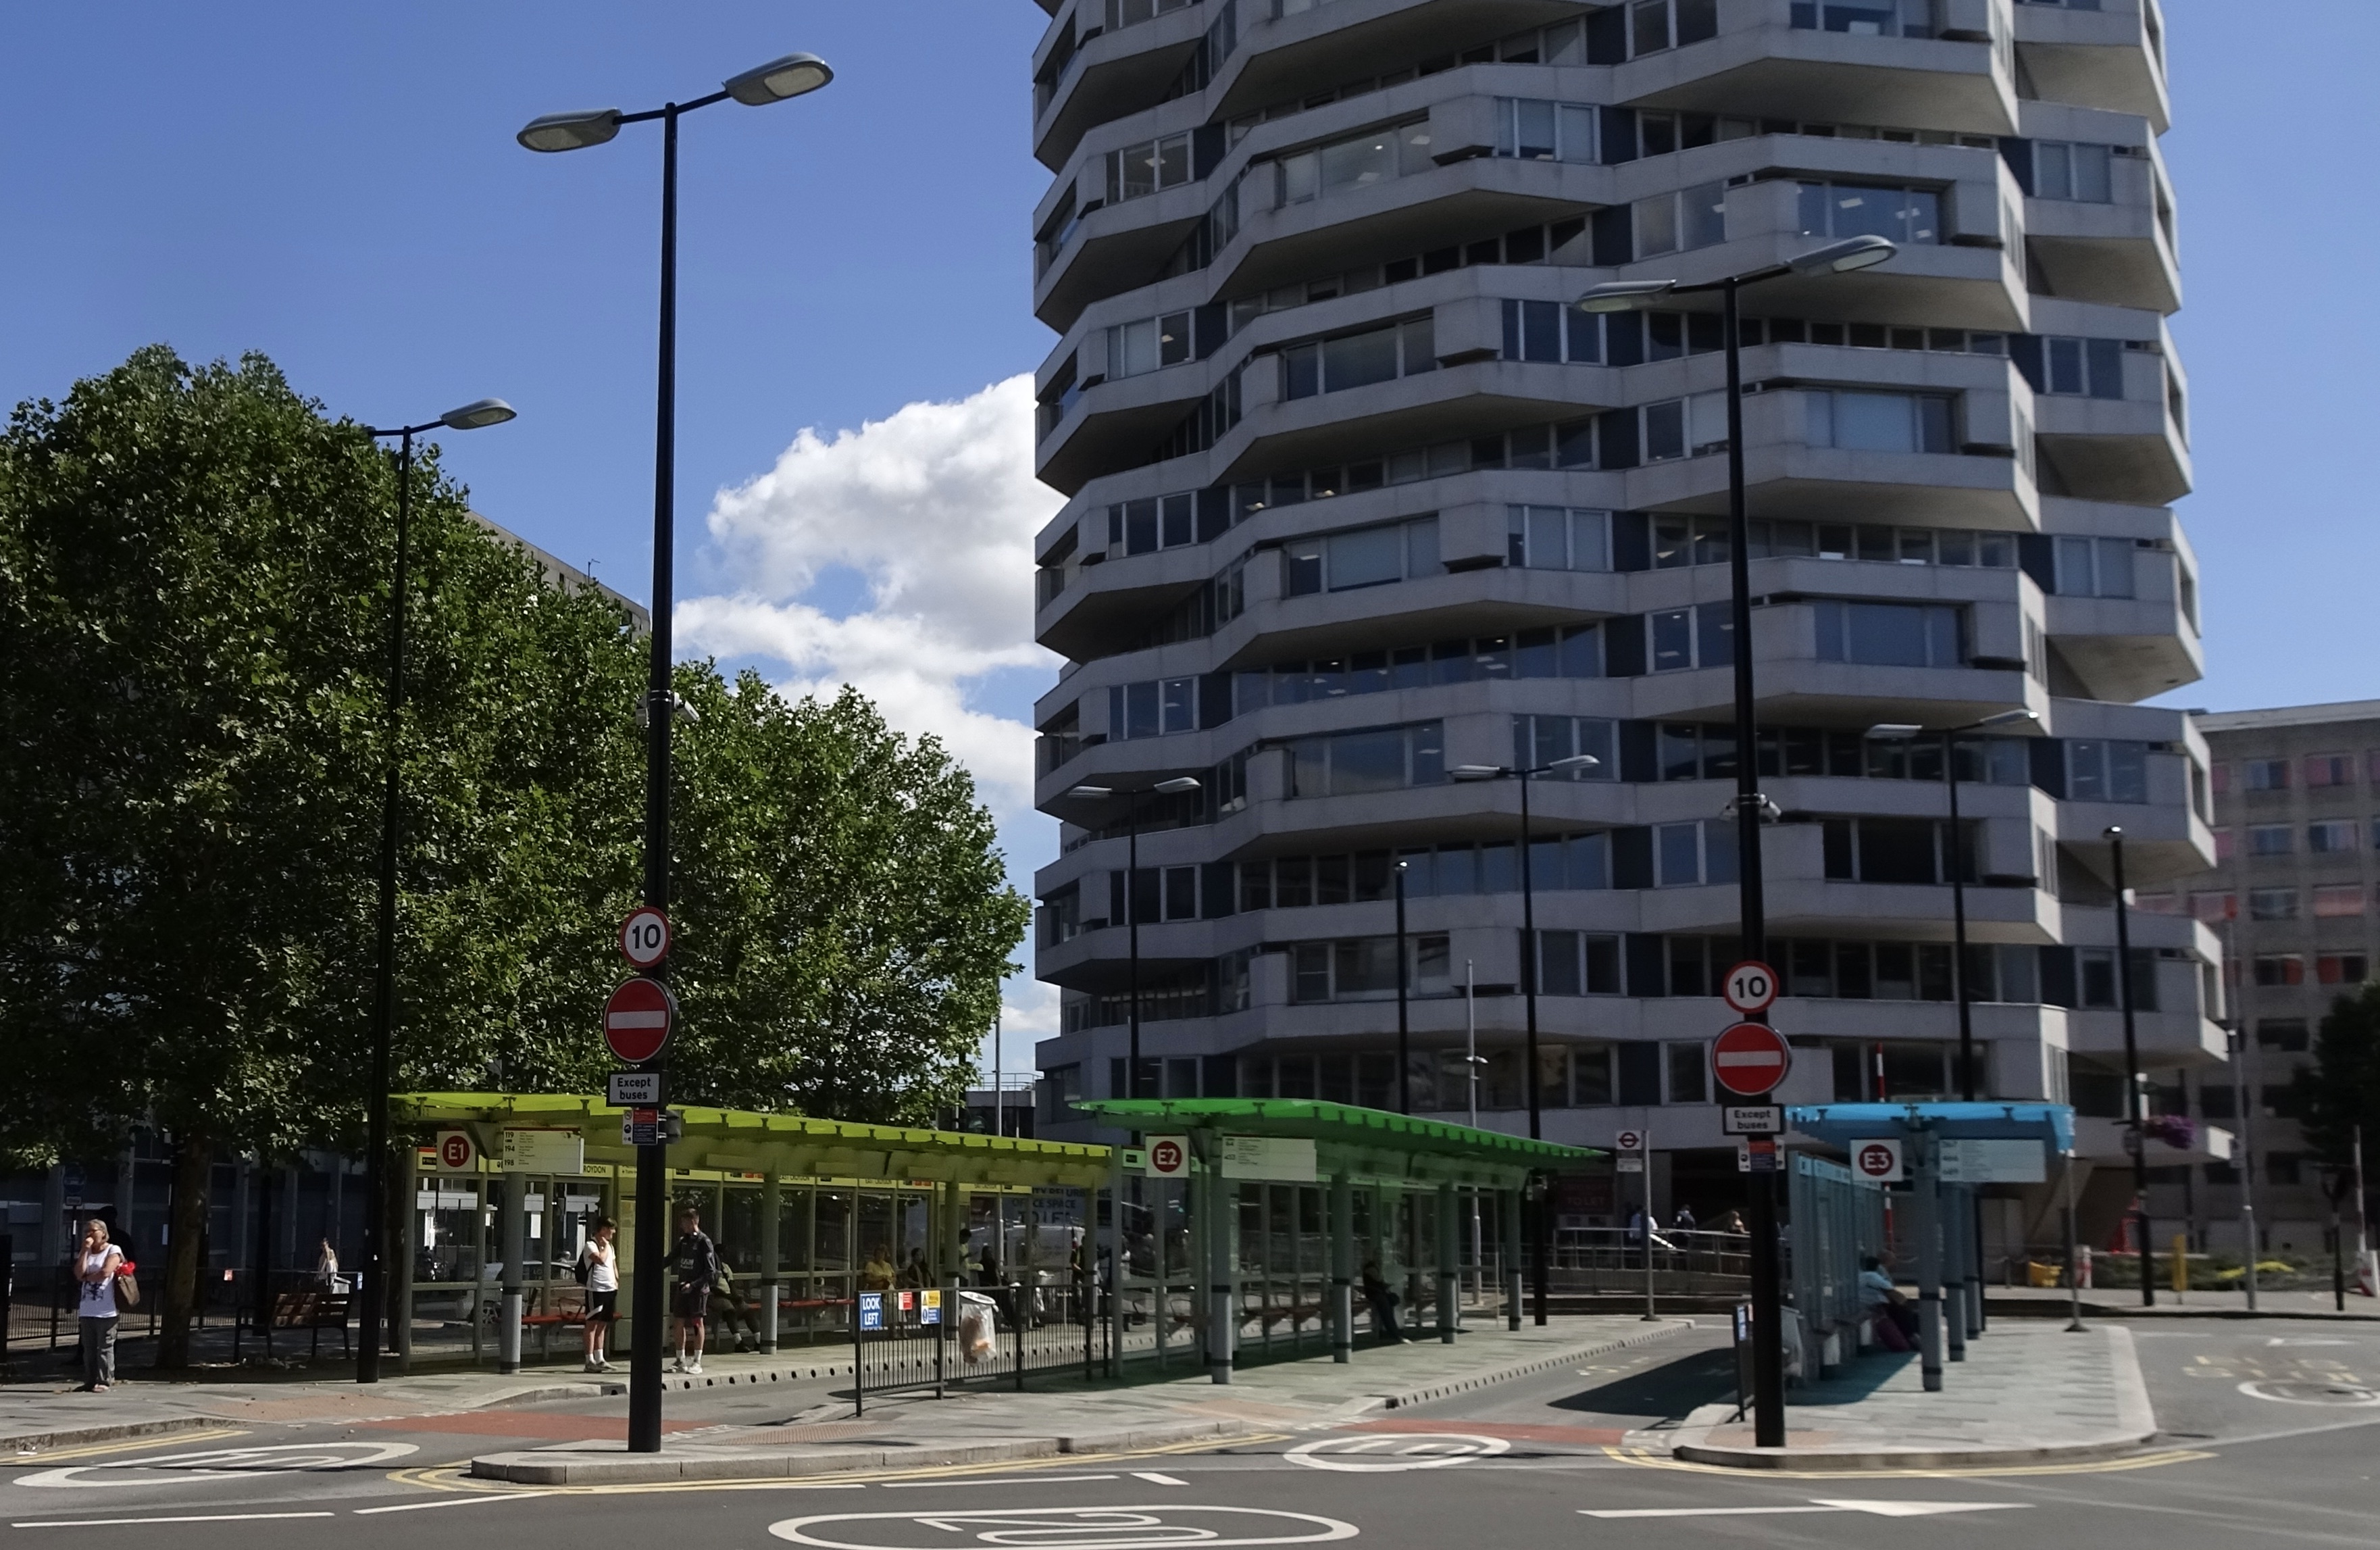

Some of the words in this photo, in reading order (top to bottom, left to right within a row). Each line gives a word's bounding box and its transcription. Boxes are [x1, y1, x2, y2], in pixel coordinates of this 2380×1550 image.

[632, 924, 661, 949] 10
[1735, 976, 1767, 999] 10
[617, 1077, 651, 1089] Except
[619, 1090, 648, 1100] buses
[1734, 1109, 1771, 1119] Except
[1737, 1121, 1769, 1129] buses
[448, 1143, 464, 1160] E1
[1157, 1148, 1178, 1165] E2
[1864, 1152, 1889, 1169] E3
[583, 1165, 606, 1174] ROYDON
[1046, 1199, 1075, 1209] SPACE
[862, 1297, 880, 1310] LOOK
[864, 1312, 879, 1326] LEFT
